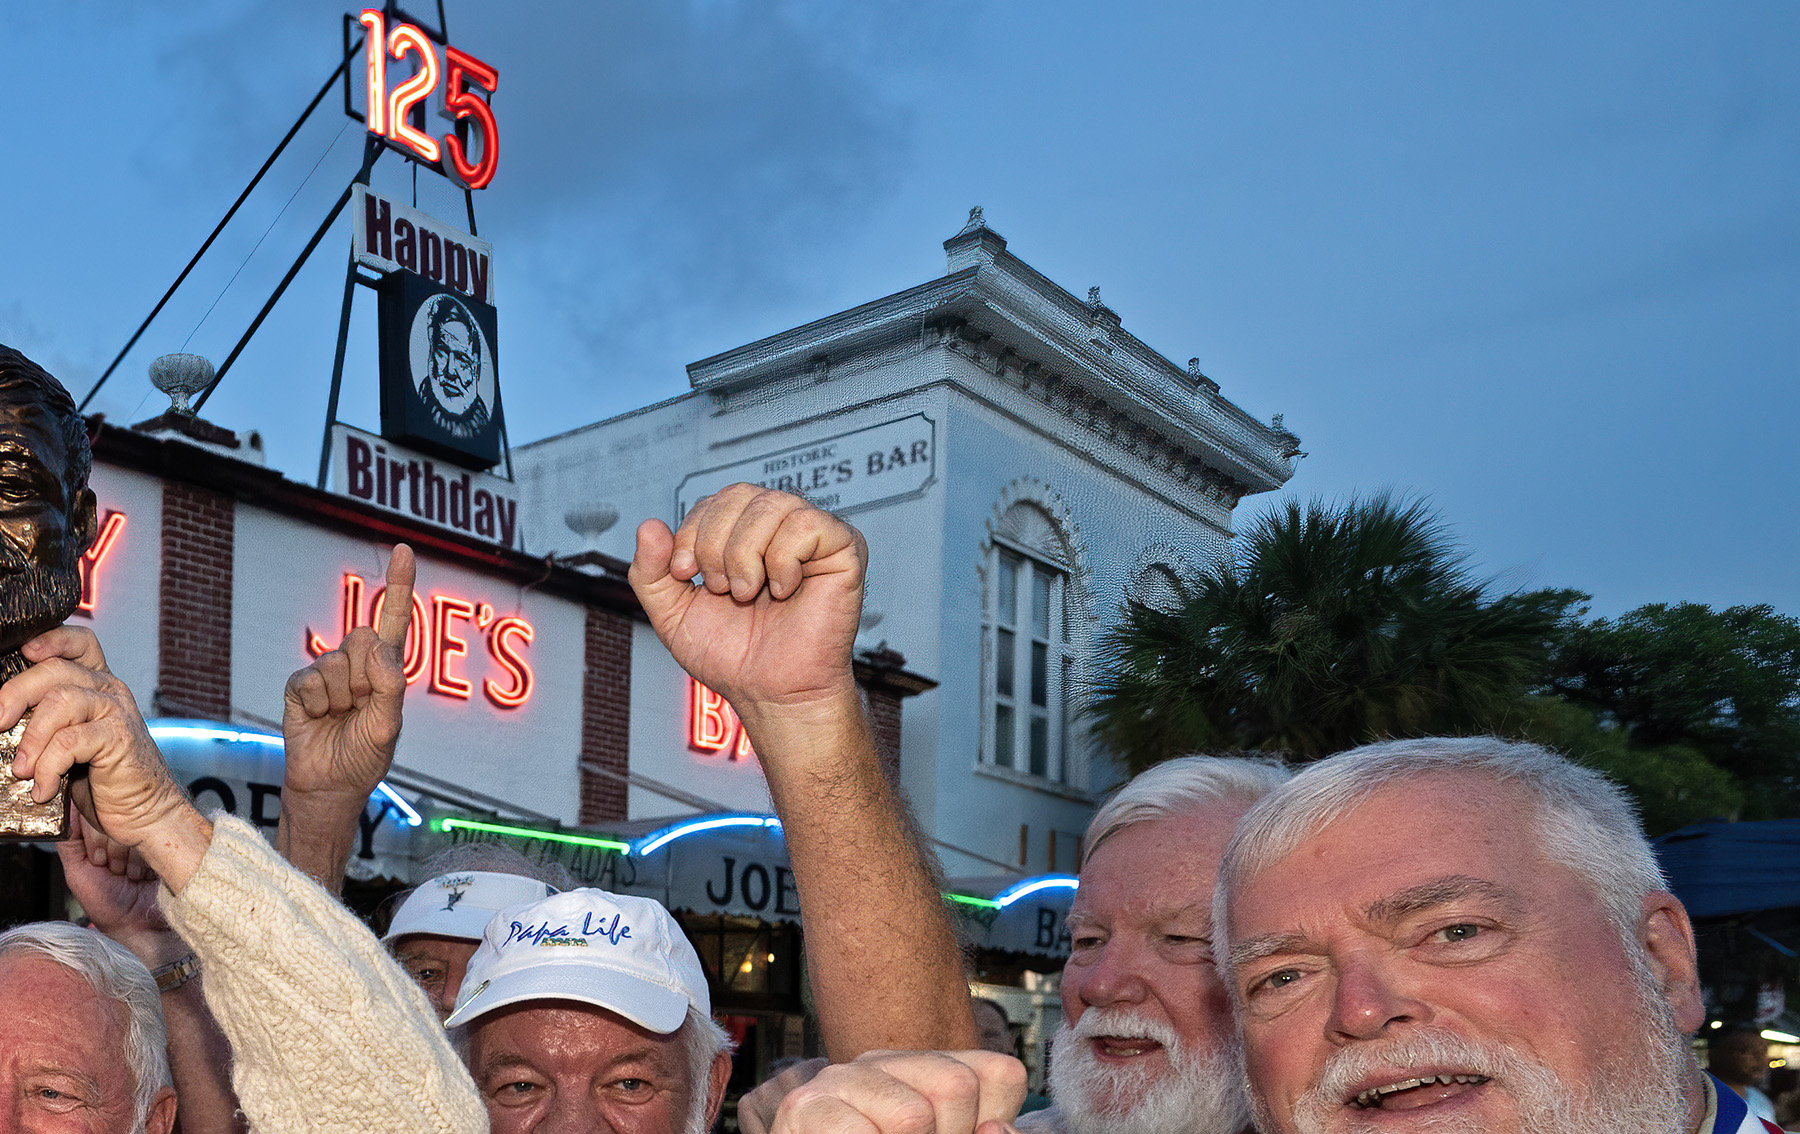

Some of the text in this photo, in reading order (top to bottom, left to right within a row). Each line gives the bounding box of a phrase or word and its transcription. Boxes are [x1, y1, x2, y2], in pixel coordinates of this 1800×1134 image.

[360, 8, 499, 189] 125
[364, 192, 488, 302] Happy
[347, 435, 517, 548] Birthday
[866, 439, 929, 477] BAR
[306, 572, 536, 710] JOE'S
[706, 856, 802, 914] JOE
[501, 911, 632, 949] Papa Life
[1034, 907, 1073, 952] BA
